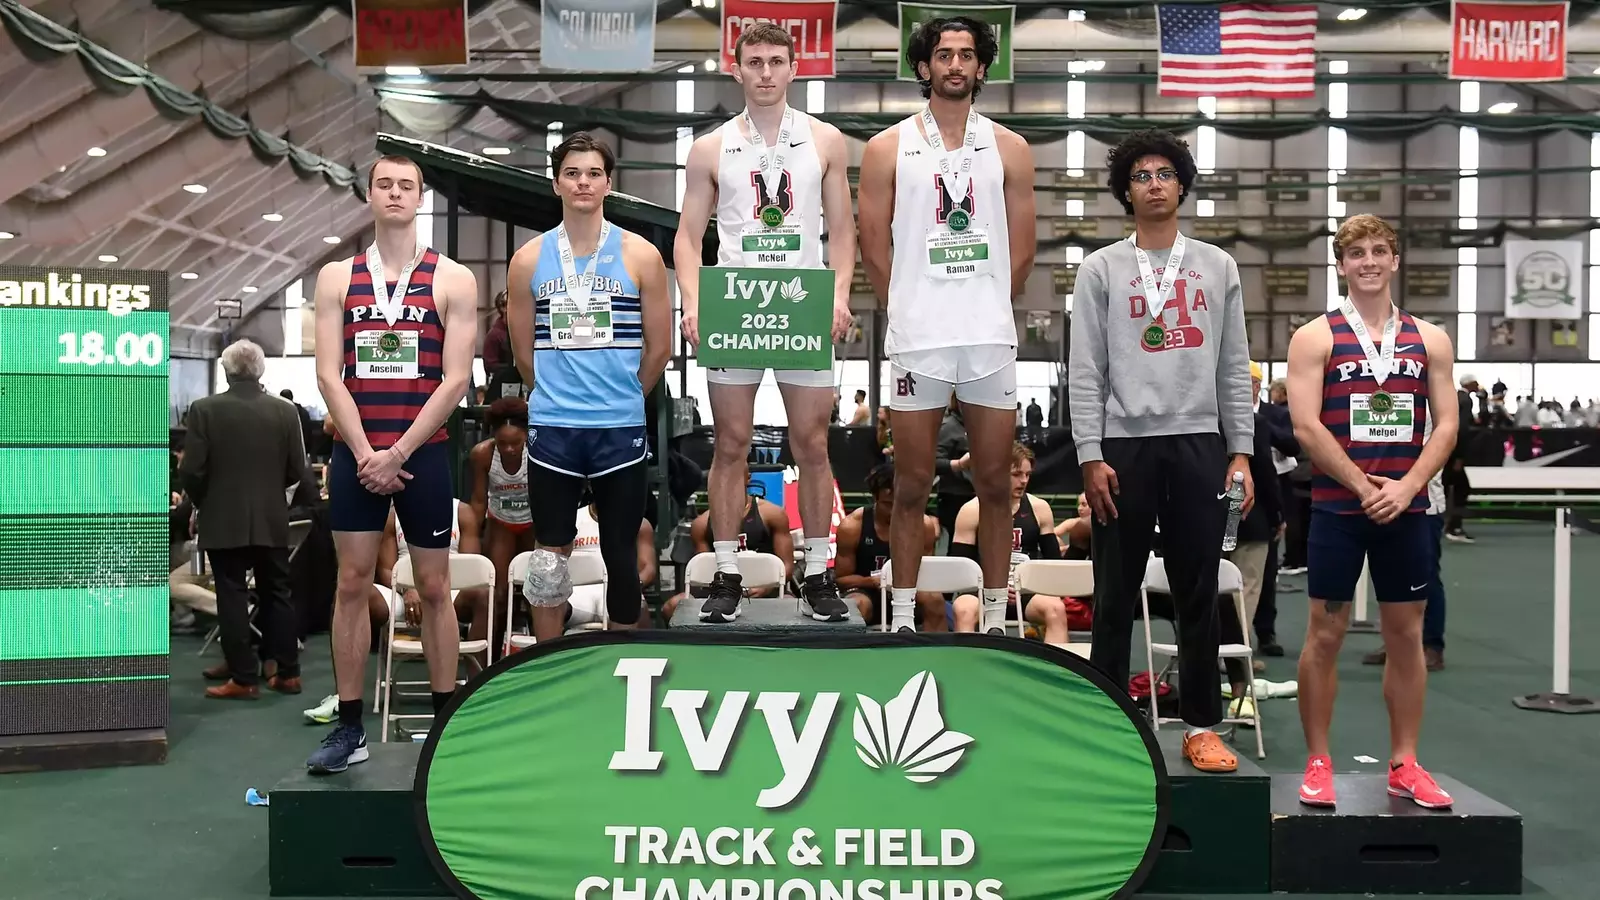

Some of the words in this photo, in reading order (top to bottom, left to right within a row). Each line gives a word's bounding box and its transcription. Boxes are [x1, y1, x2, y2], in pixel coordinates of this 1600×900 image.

[359, 8, 463, 50] BROWN
[726, 16, 830, 59] CELL
[1460, 17, 1559, 62] HARVARD
[757, 236, 777, 250] Ivy
[758, 254, 786, 262] McNeil
[944, 248, 964, 260] Ivy
[946, 264, 975, 274] Raman
[1188, 270, 1203, 281] OF
[724, 272, 778, 308] Ivy
[741, 313, 789, 329] 2023
[58, 331, 163, 366] 18.00
[708, 333, 822, 351] CHAMPION
[372, 347, 390, 360] Ivy
[370, 364, 404, 374] Anselmi
[897, 377, 909, 396] B
[1368, 411, 1387, 424] Ivy
[1369, 428, 1397, 437] Meigel
[511, 501, 525, 509] Ivy
[607, 658, 841, 809] Ivy
[604, 826, 777, 866] TRACK
[787, 827, 823, 866] &
[835, 828, 976, 866] FIELD
[574, 875, 1004, 900] CHAMPIONSHIPS
